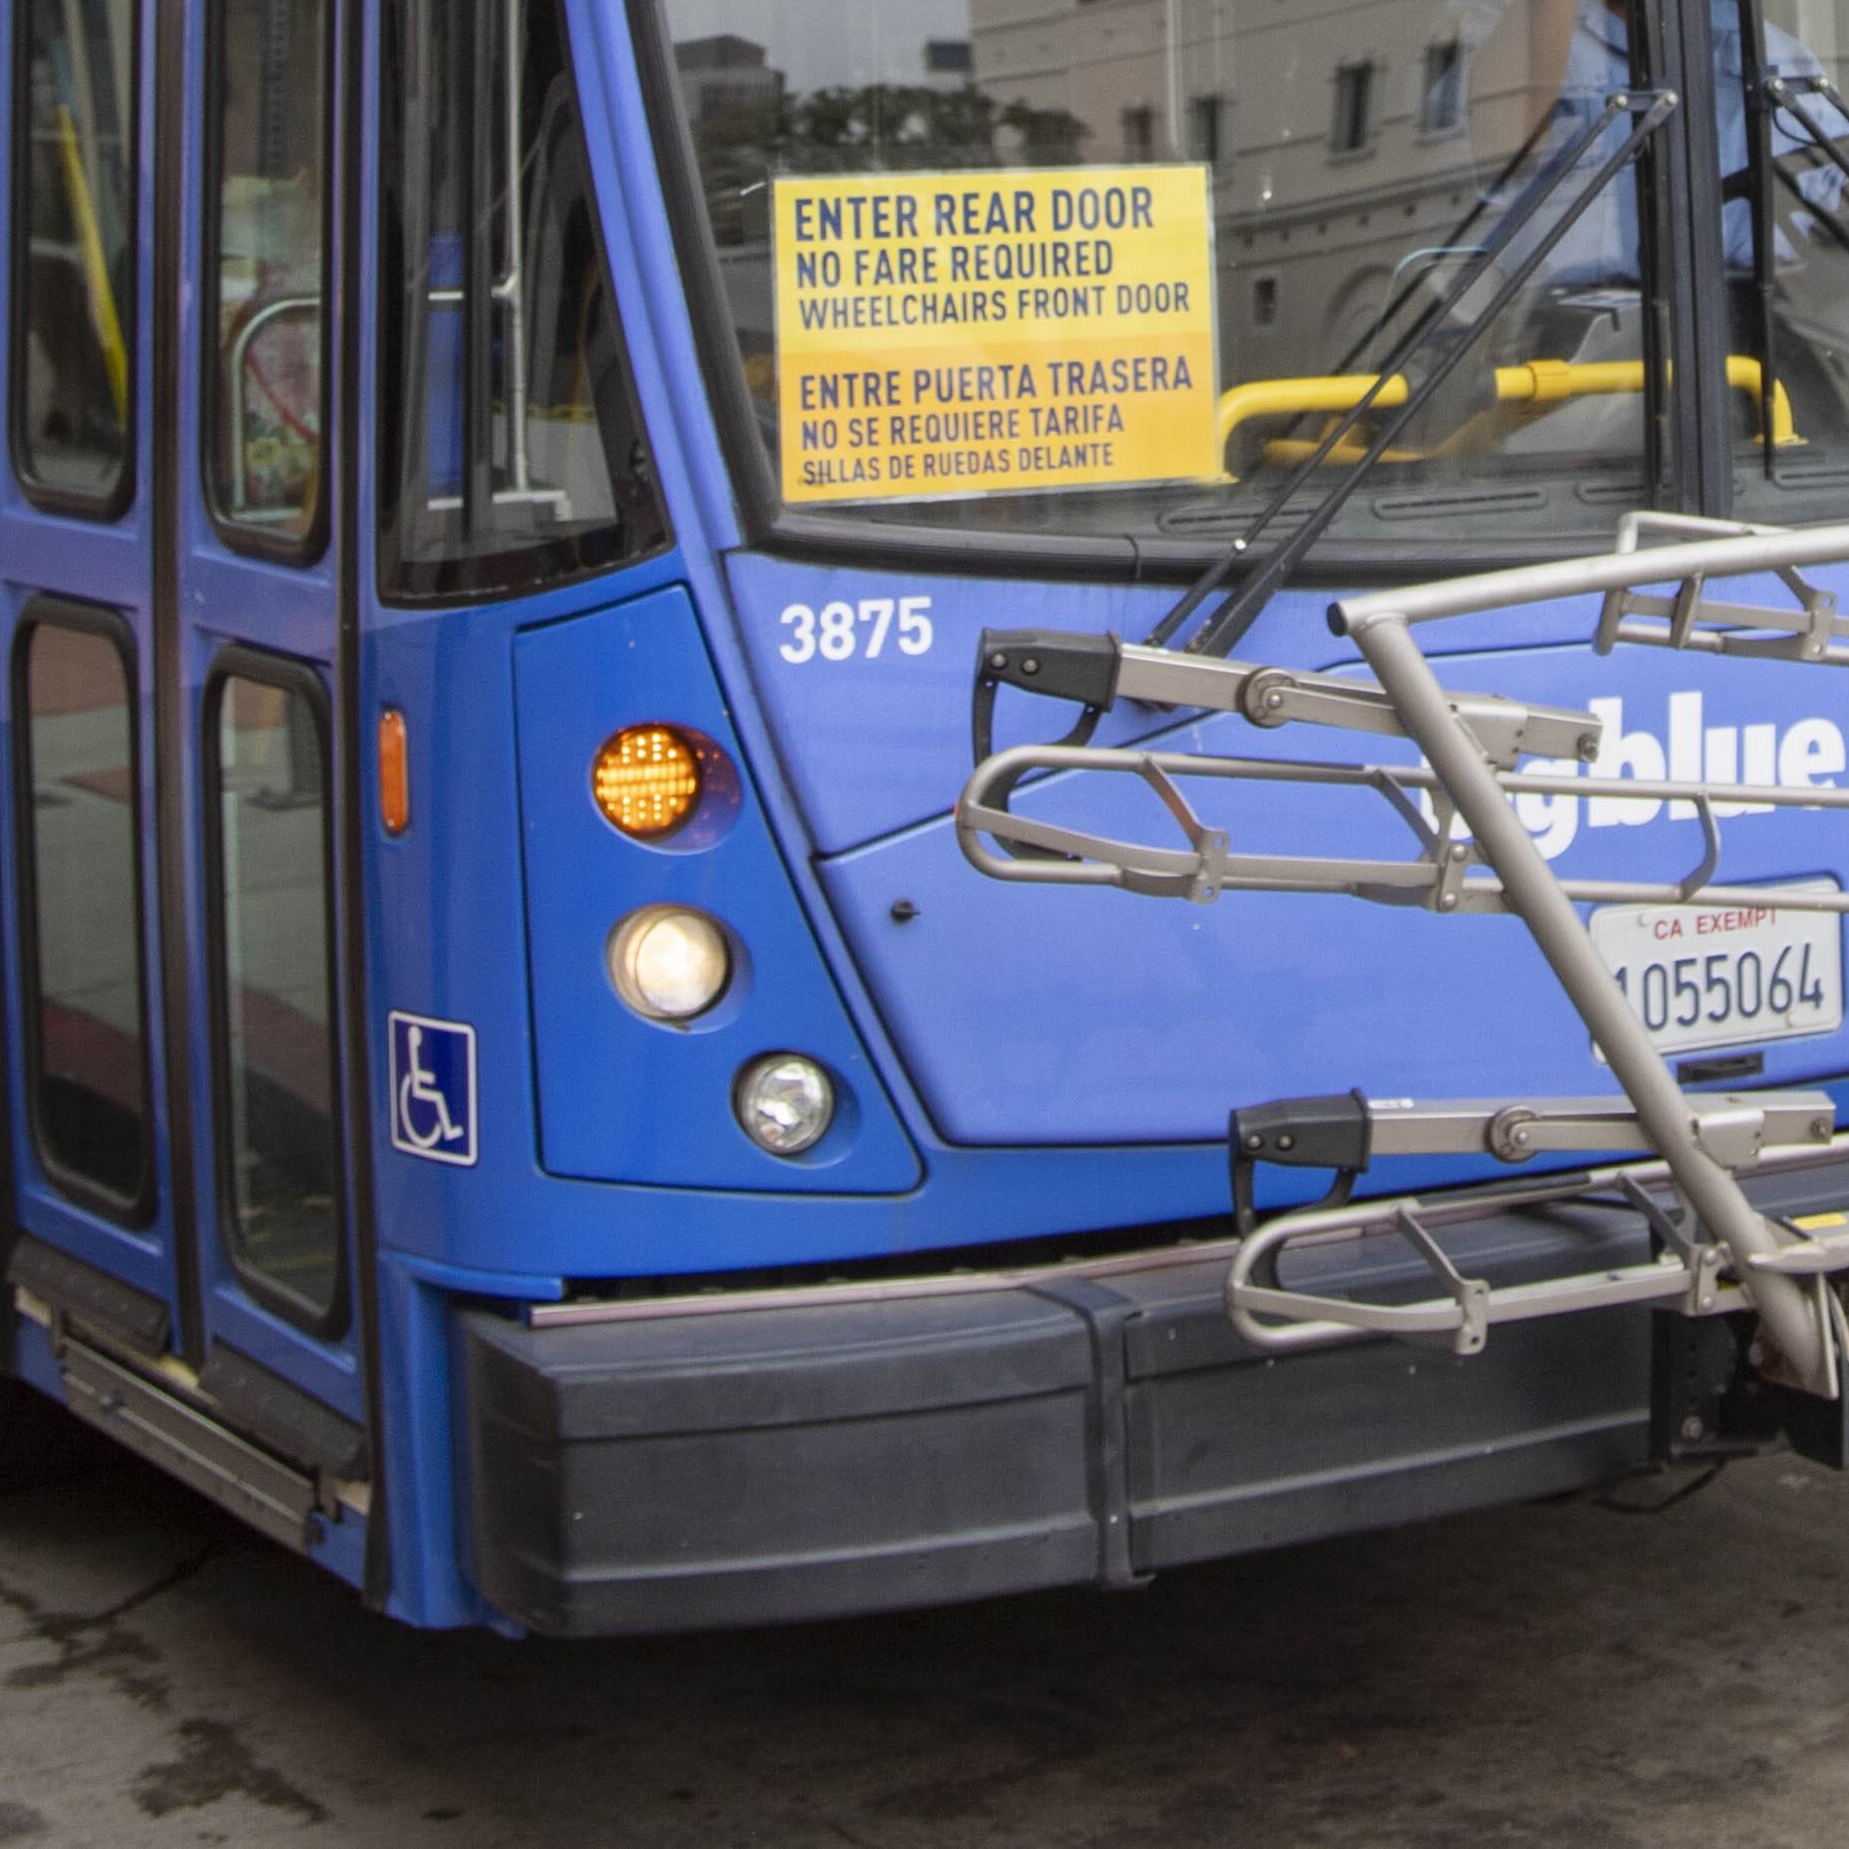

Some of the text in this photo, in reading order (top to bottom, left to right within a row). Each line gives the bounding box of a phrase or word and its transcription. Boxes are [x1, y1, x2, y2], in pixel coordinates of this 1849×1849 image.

[794, 186, 1154, 242] ENTER REAR DOOR
[797, 239, 1113, 289] NO FARE REQUIRED
[799, 282, 1191, 330] WHEELCHAIRS FRONT DOOR
[800, 355, 1193, 411] ENTRE PUERTA TRASERA
[801, 403, 1124, 450] NO SE REQUIERE TARIFA
[803, 443, 1113, 486] SILLAS DE RUEDAS DELANTE
[779, 596, 934, 664] 3875
[1587, 691, 1847, 828] blue
[1653, 904, 1778, 941] CA EXEMPT
[1613, 942, 1825, 1032] 1055064
